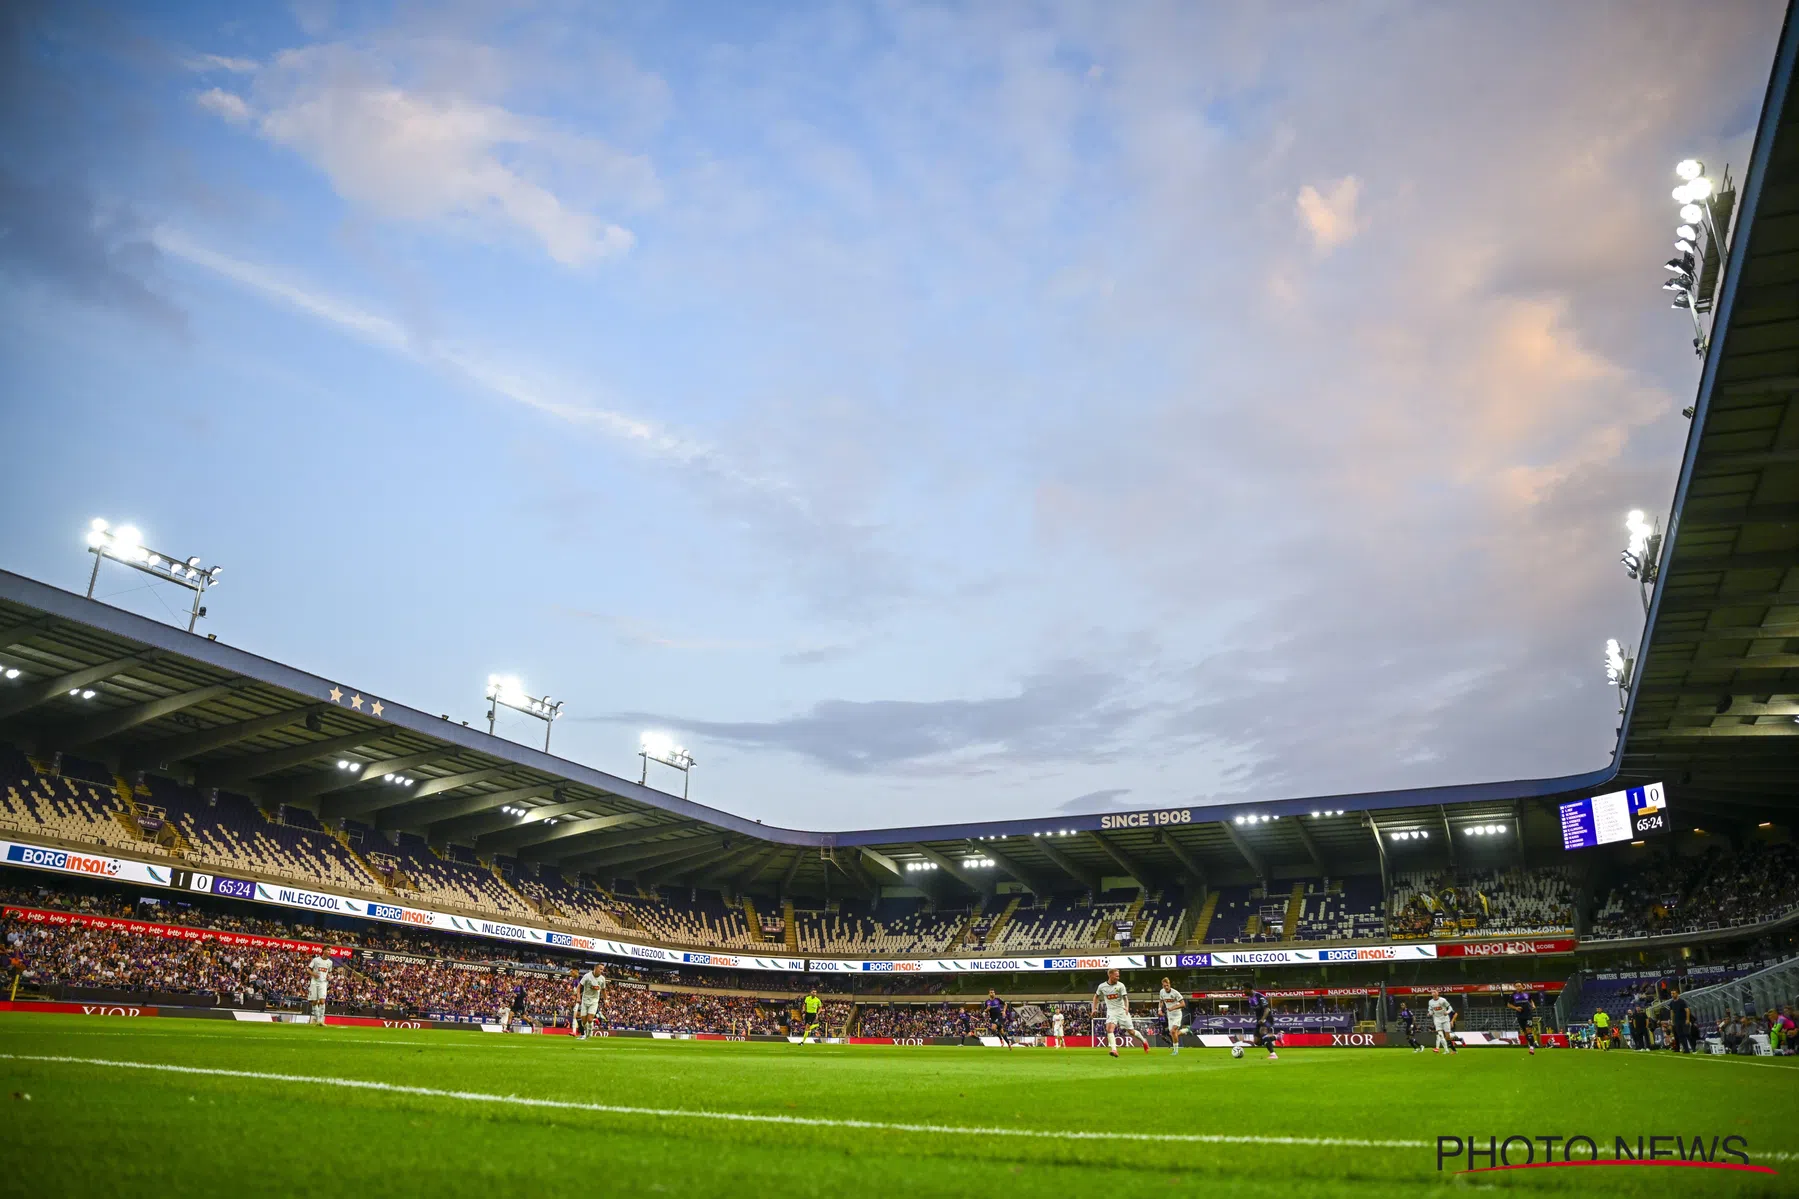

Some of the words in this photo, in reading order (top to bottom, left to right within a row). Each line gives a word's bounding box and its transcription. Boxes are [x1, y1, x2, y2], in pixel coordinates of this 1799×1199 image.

[1633, 792, 1639, 806] 1
[1650, 788, 1659, 802] 0
[1101, 813, 1149, 829] SINCE
[1153, 810, 1191, 825] 1908
[1637, 816, 1663, 831] 65:24
[179, 872, 185, 887] 1
[196, 875, 208, 889] 0
[218, 880, 251, 897] 65:24
[279, 888, 340, 910] INLEGZOOL
[481, 923, 526, 939] INLEGZOOL
[631, 947, 666, 960] INLEGZOOL
[1464, 942, 1537, 955] NAPOLEON
[384, 954, 427, 965] EUROSTAR2000
[1151, 956, 1155, 967] 1
[1164, 956, 1173, 966] 0
[1181, 955, 1208, 966] 65:24
[1232, 952, 1291, 964] INLEGZOOL
[788, 961, 840, 971] INLGZOOL
[970, 961, 1020, 970] INLEGZOOL
[1332, 1034, 1375, 1046] XIOR
